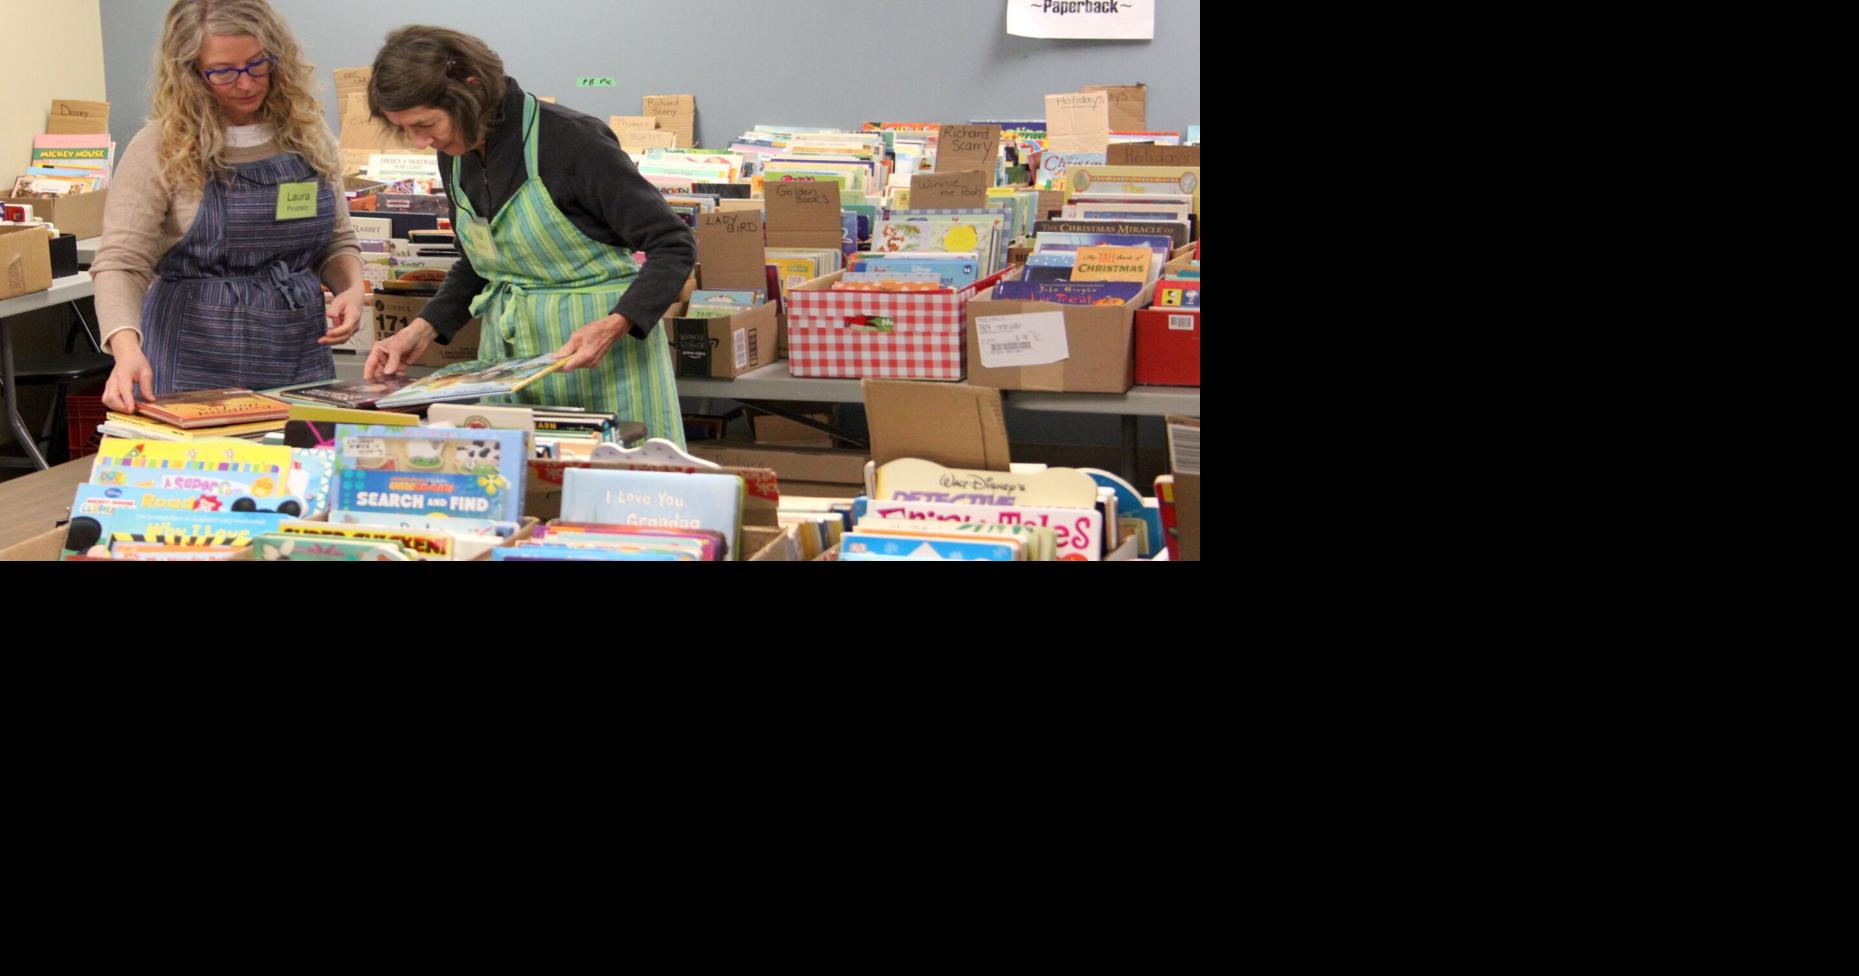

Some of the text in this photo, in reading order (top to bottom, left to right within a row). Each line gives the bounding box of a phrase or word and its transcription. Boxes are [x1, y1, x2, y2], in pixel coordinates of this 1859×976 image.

[1057, 95, 1105, 110] Holidays
[944, 125, 989, 140] Richard
[40, 150, 105, 159] MICKEY MOUSE
[953, 138, 993, 164] Scarry
[1126, 150, 1191, 164] Holidays
[776, 183, 817, 196] Golden
[919, 178, 961, 191] Winnie
[287, 192, 311, 202] Laura
[940, 186, 982, 197] the Pooh
[706, 214, 738, 226] LADY
[352, 224, 382, 233] RABBIT
[727, 222, 758, 233] BIRD
[1059, 223, 1116, 232] CHRISTMAS
[1117, 224, 1162, 234] MIRACLE
[1077, 263, 1145, 273] CHRISTMAS
[1064, 286, 1098, 294] Grogan
[356, 491, 489, 512] SEARCH AND FIND
[606, 490, 611, 504] I
[618, 490, 651, 505] Love
[353, 531, 447, 556] KEN!
